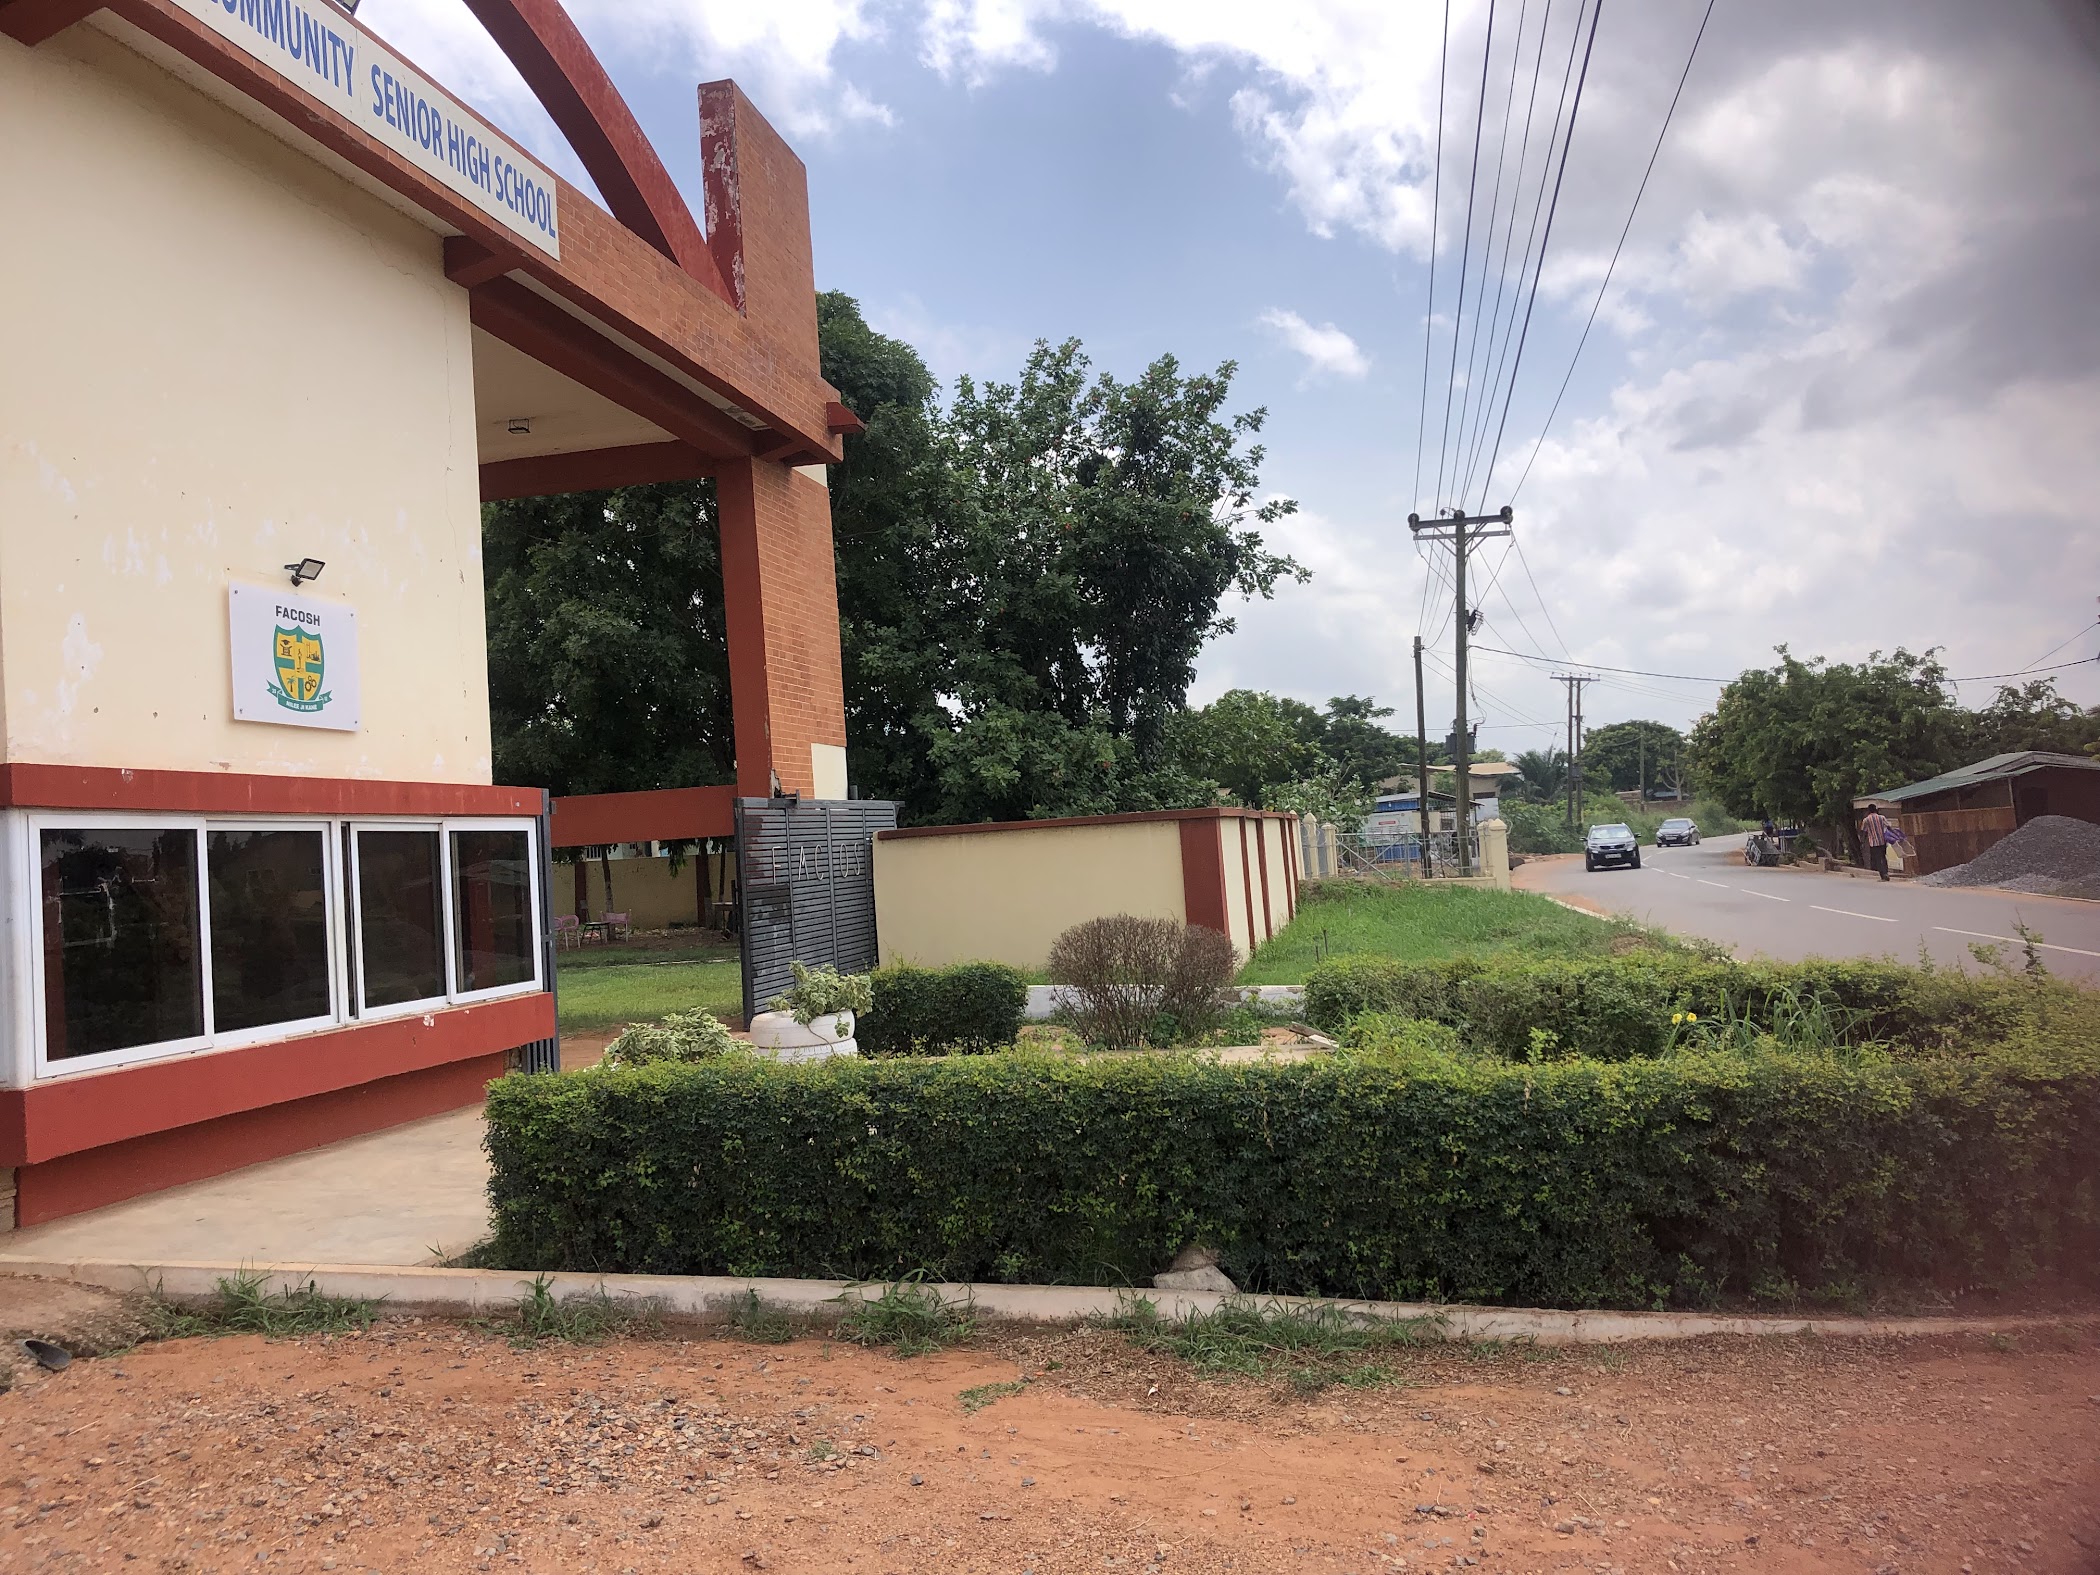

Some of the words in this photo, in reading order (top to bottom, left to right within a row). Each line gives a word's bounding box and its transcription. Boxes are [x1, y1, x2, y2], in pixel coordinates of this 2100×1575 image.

[211, 0, 354, 97] MMUNITY
[371, 63, 445, 161] SENIOR
[447, 119, 492, 193] HIGH
[494, 155, 556, 238] SCHOOL
[275, 605, 321, 627] FACOSH
